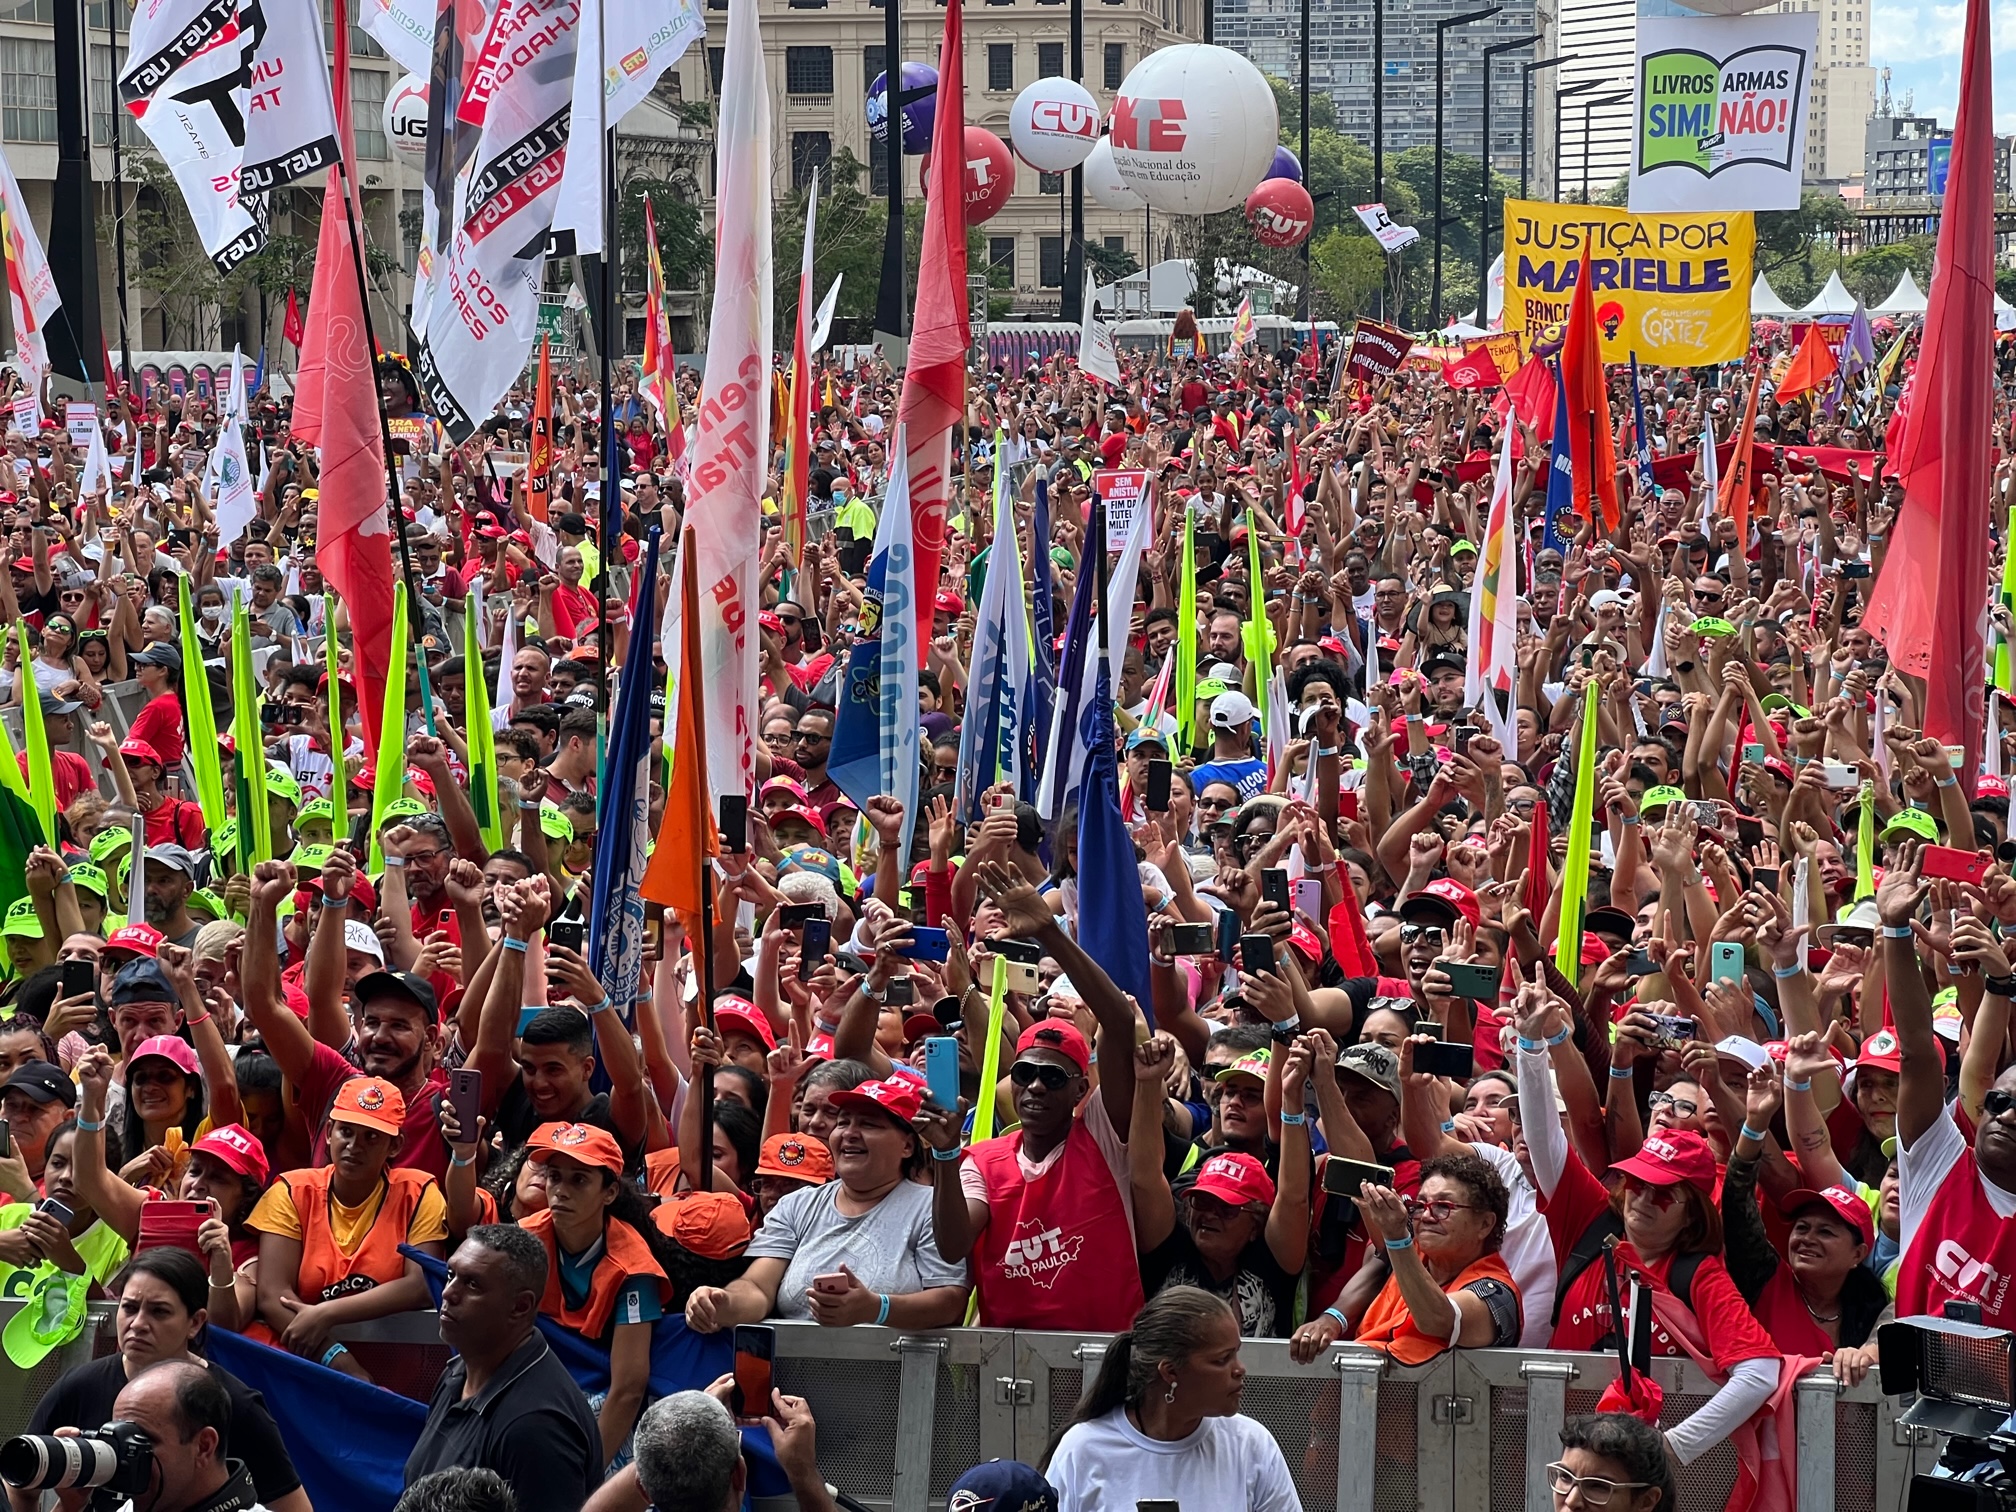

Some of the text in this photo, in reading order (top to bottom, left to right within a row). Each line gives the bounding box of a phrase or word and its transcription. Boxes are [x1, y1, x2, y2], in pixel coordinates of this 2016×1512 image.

[1652, 70, 1789, 95] LIVROS ARMAS
[1032, 102, 1098, 138] CUT
[1648, 92, 1787, 138] SIM! NÃO!
[391, 116, 427, 138] UG
[1132, 157, 1172, 170] Nacional
[1176, 160, 1196, 170] dos
[1150, 171, 1201, 182] Educação
[1516, 218, 1729, 256] JUSTIÇA POR
[1517, 255, 1731, 293] MARIELLE
[1641, 307, 1709, 348] CORTEZ
[431, 380, 465, 428] UGT
[1115, 477, 1132, 487] SEM
[1109, 487, 1139, 497] ANISTIA
[1110, 501, 1126, 510] FIM
[1110, 510, 1133, 519] TUTEL
[1108, 520, 1130, 530] MILIT
[1697, 617, 1720, 630] CSB
[1650, 786, 1676, 797] CSB
[1977, 779, 2003, 791] CUT
[391, 799, 419, 810] CSB
[1891, 808, 1922, 822] CSB
[98, 828, 123, 843] CSB
[219, 823, 237, 841] CS
[72, 866, 98, 878] CSB
[117, 927, 151, 943] CUT
[346, 933, 369, 945] AN
[1644, 1137, 1673, 1155] CUT
[1207, 1159, 1242, 1177] CUT
[1005, 1227, 1062, 1267] CUT
[1004, 1251, 1070, 1279] SÃO PAULO
[1935, 1240, 1998, 1300] CUT
[1993, 1274, 2012, 1309] BRASIL
